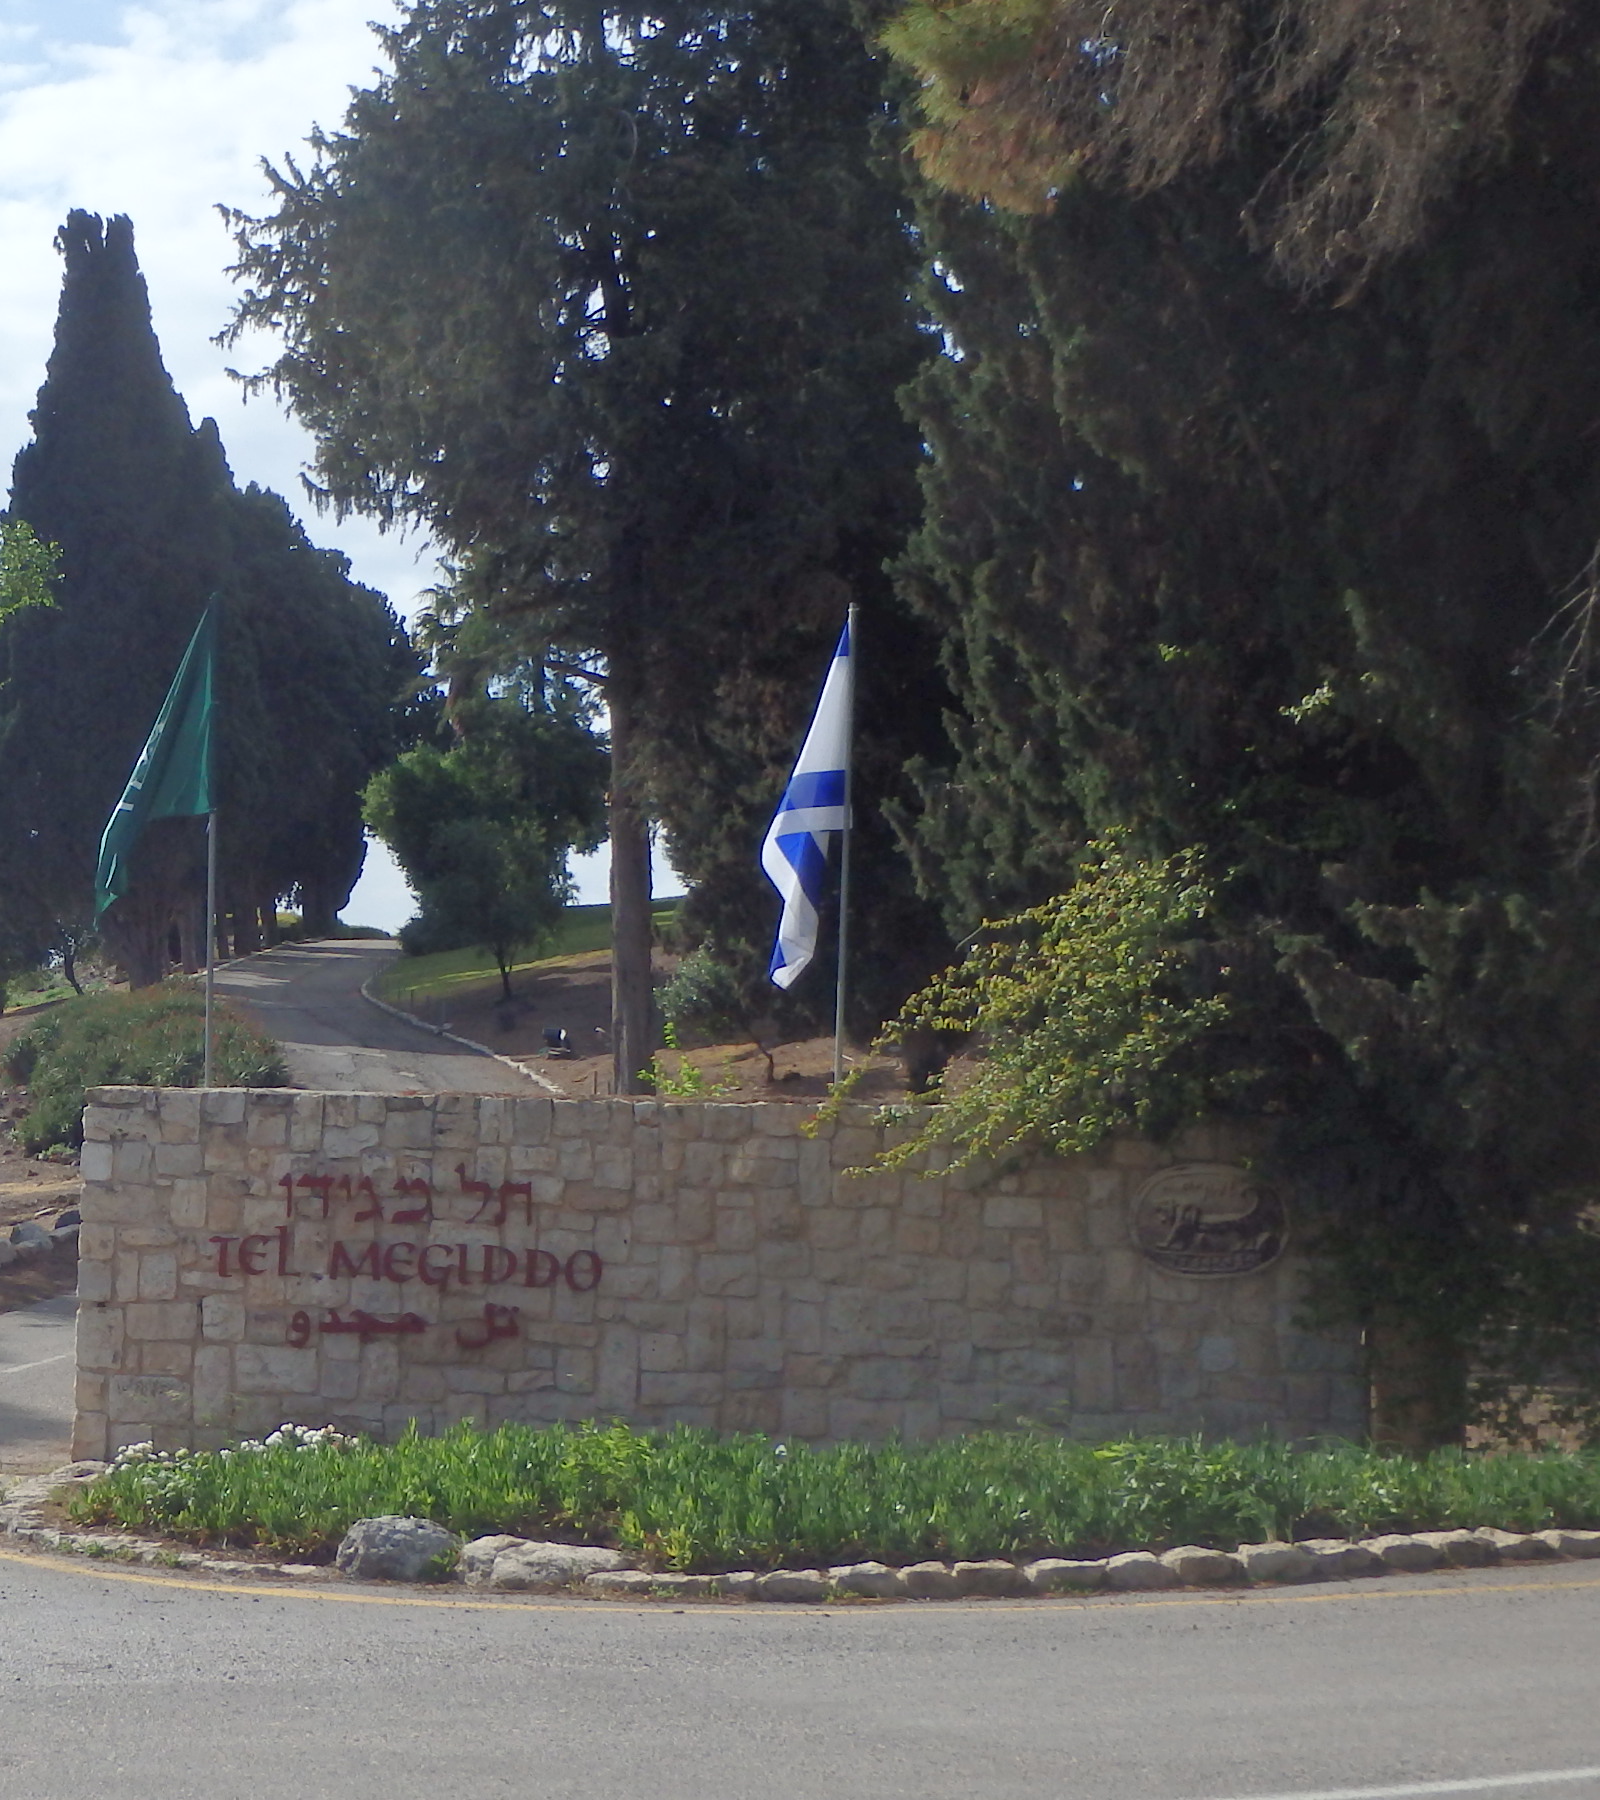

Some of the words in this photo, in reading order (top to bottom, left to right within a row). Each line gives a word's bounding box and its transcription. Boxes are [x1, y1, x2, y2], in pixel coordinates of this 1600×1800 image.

[278, 1172, 440, 1225] מגידו
[454, 1162, 532, 1226] תל
[209, 1225, 302, 1278] TEL
[328, 1240, 602, 1292] MEGIDDO
[286, 1308, 428, 1348] مجدو
[455, 1302, 520, 1348] تل
